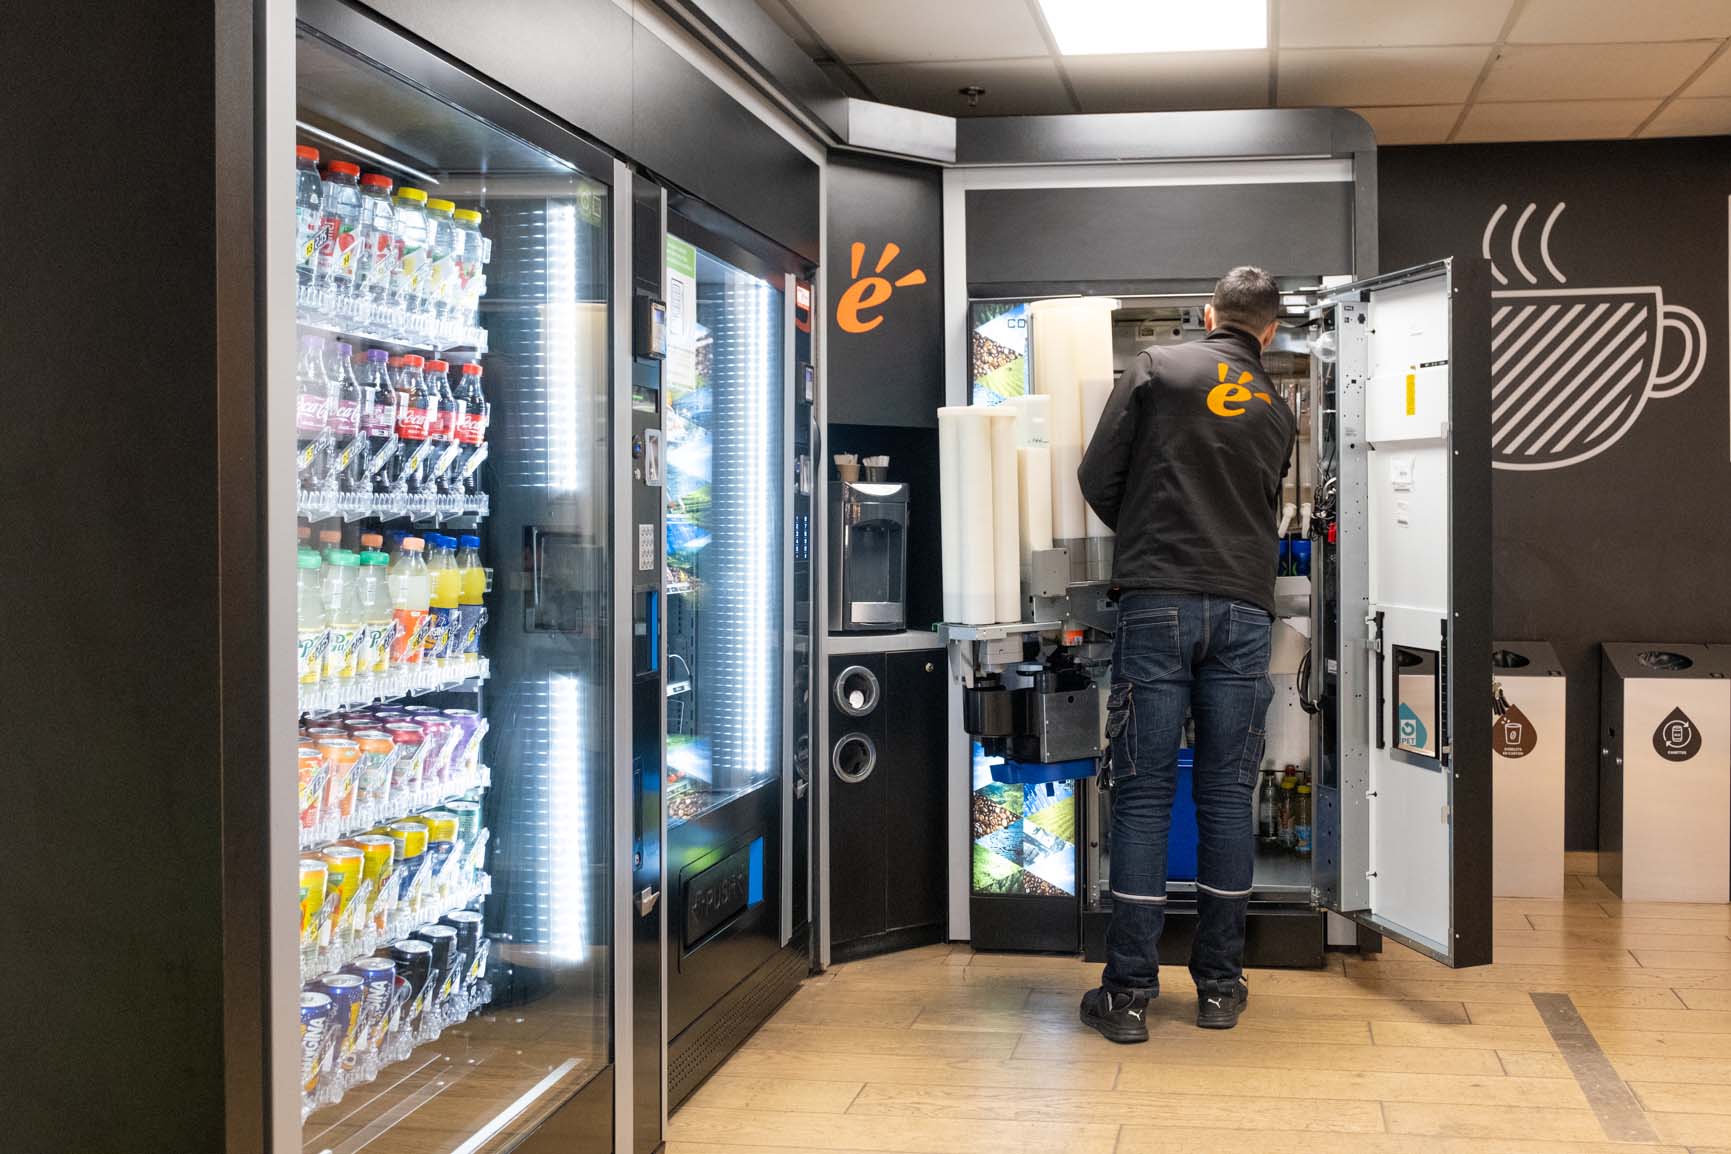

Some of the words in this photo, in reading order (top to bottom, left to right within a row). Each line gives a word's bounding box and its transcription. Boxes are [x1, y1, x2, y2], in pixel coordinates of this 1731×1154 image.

[836, 276, 893, 334] e
[1008, 318, 1026, 329] CO
[1206, 383, 1253, 417] e
